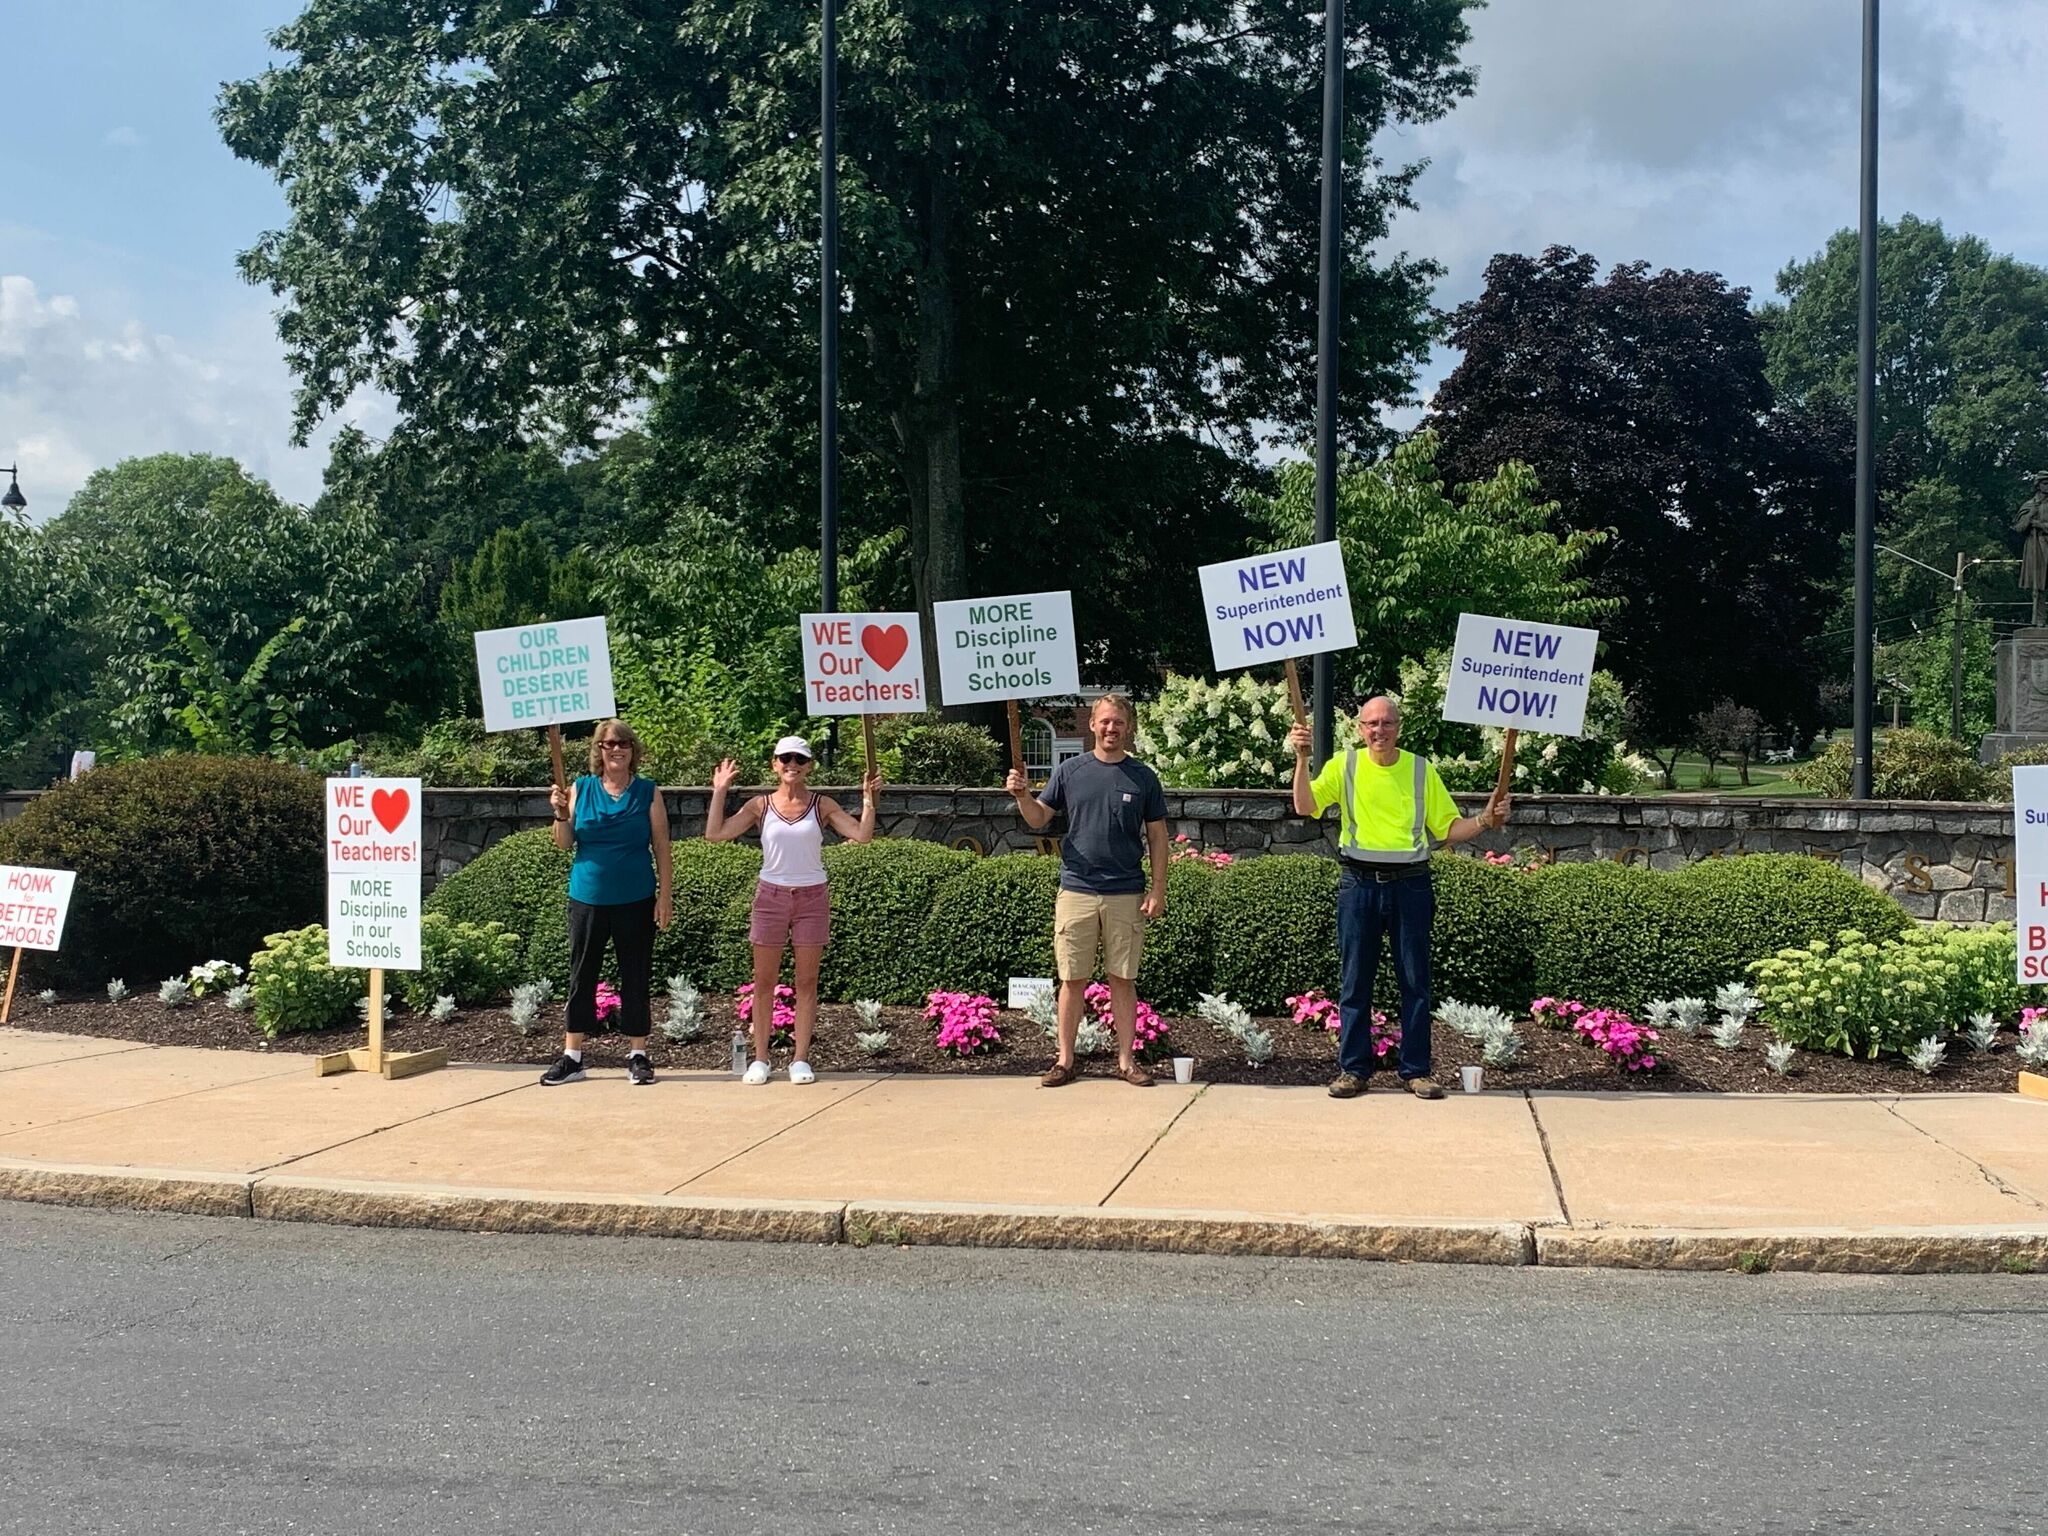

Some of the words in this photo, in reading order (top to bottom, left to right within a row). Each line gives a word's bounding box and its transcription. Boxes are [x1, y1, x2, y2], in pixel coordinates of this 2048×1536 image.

[1238, 557, 1305, 593] NEW
[969, 602, 1033, 625] MORE
[1216, 584, 1343, 620] Superintendent
[519, 627, 559, 649] OUR
[811, 621, 853, 646] WE
[955, 624, 1057, 649] Discipline
[1243, 613, 1325, 651] NOW!
[1492, 628, 1562, 660] NEW
[496, 644, 590, 674] CHILDREN
[819, 652, 864, 675] Our
[976, 651, 995, 669] in
[1002, 650, 1036, 667] our
[503, 668, 590, 697] DESERVE
[968, 667, 1052, 691] Schools
[1461, 657, 1585, 686] Superintendent
[810, 677, 920, 702] Teachers!
[511, 692, 590, 719] BETTER!
[1477, 685, 1558, 719] NOW!
[334, 786, 365, 808] WE
[338, 813, 372, 836] Our
[331, 840, 417, 861] Teachers!
[8, 872, 56, 893] HONK
[350, 880, 392, 897] MORE
[340, 900, 408, 921] Discipline
[352, 921, 364, 937] in
[368, 925, 392, 938] our
[346, 939, 402, 959] Schools
